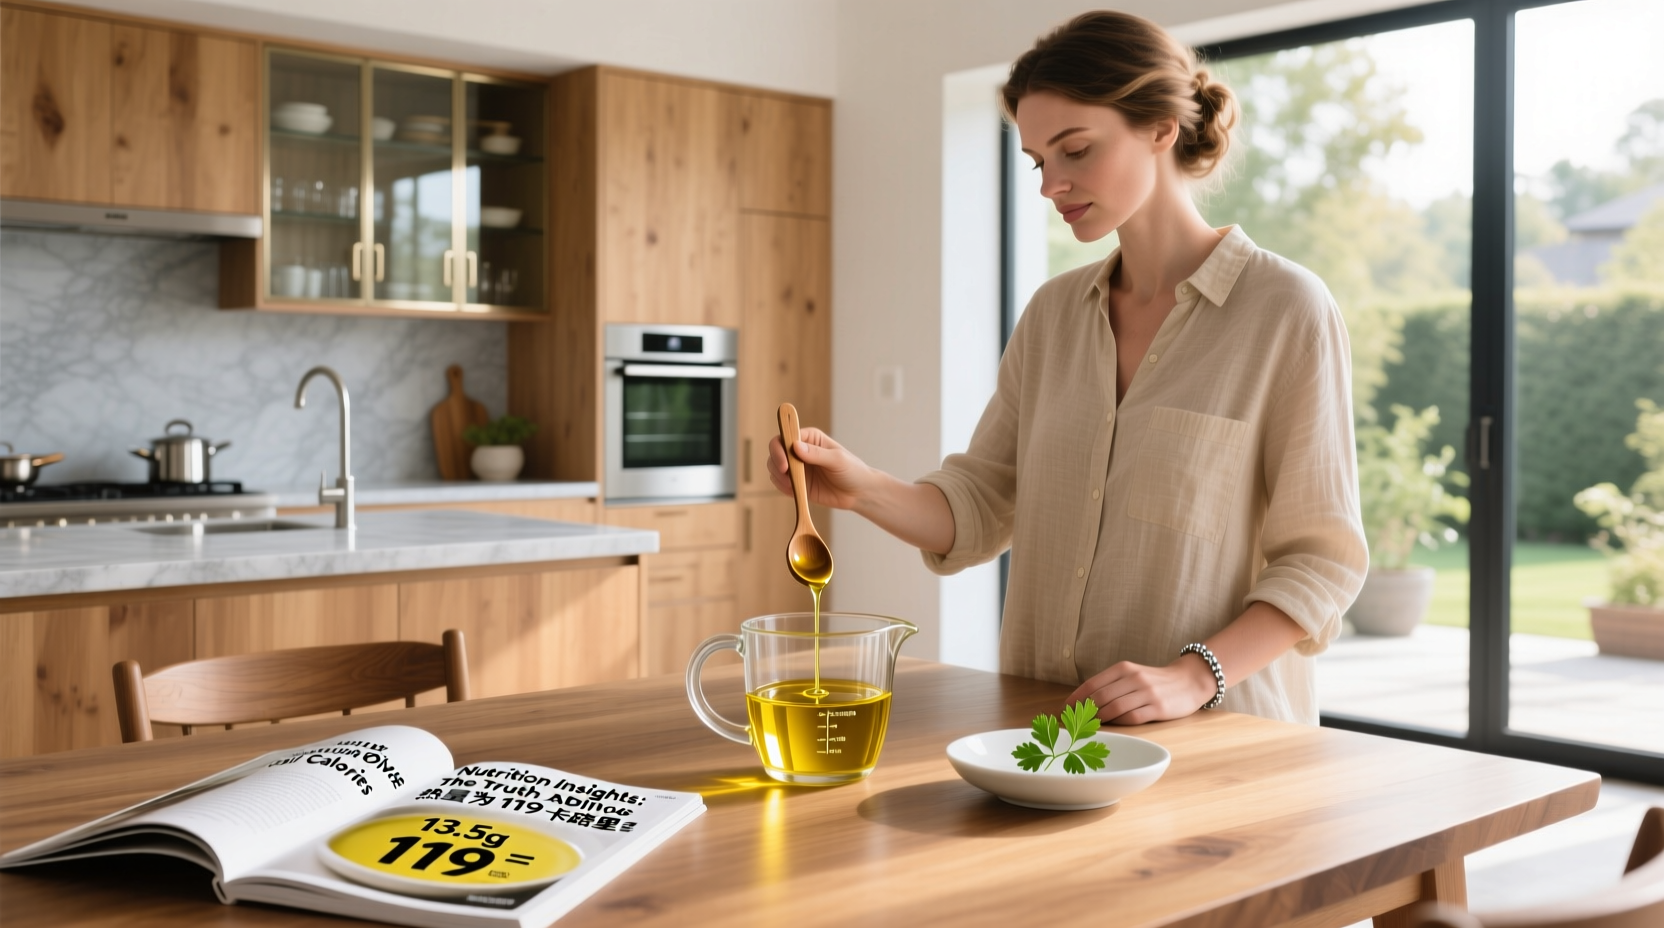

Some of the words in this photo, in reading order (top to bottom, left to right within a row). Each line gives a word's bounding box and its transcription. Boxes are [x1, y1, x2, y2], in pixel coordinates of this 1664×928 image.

[306, 754, 373, 796] Calories
[457, 766, 551, 787] Nutrition
[553, 779, 647, 806] Insights:
[483, 779, 541, 799] Truth
[501, 797, 544, 814] 119
[421, 817, 511, 849] 13.5g
[377, 836, 496, 877] 119
